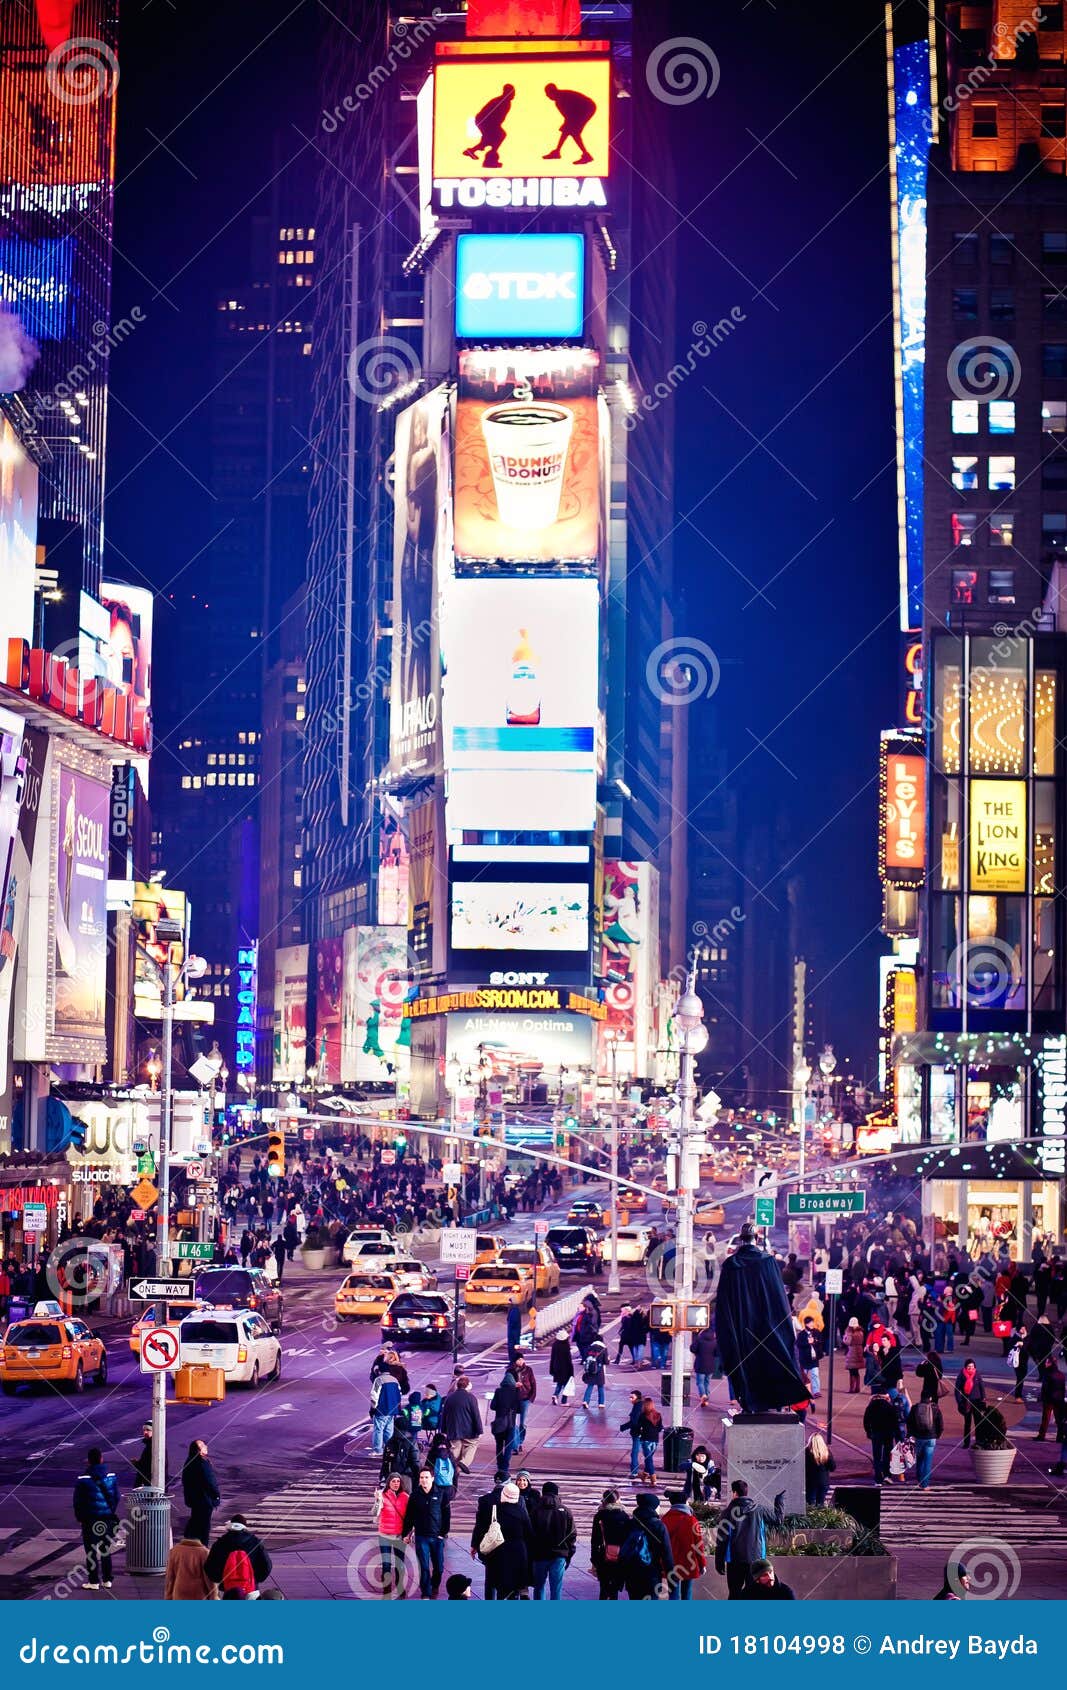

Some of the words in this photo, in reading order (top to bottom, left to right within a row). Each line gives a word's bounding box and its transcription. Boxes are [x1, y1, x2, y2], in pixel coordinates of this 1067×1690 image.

[433, 177, 607, 207] TOSHIBA
[489, 272, 577, 299] TDK
[508, 463, 561, 478] DONUTS
[391, 693, 436, 741] UFFALO
[112, 766, 127, 837] 1500
[983, 801, 1013, 816] THE
[76, 813, 105, 862] SEOUL
[977, 821, 1019, 846] LION
[976, 850, 1020, 876] KING
[489, 971, 550, 986] SONY
[464, 1018, 519, 1032] All-New
[522, 1018, 574, 1034] Optima
[9, 1185, 59, 1211] HOLLYWOOD
[799, 1197, 854, 1210] Broadway
[181, 1242, 189, 1257] W
[190, 1244, 201, 1257] 46
[138, 1284, 157, 1294] ONE
[165, 1285, 186, 1294] WAY
